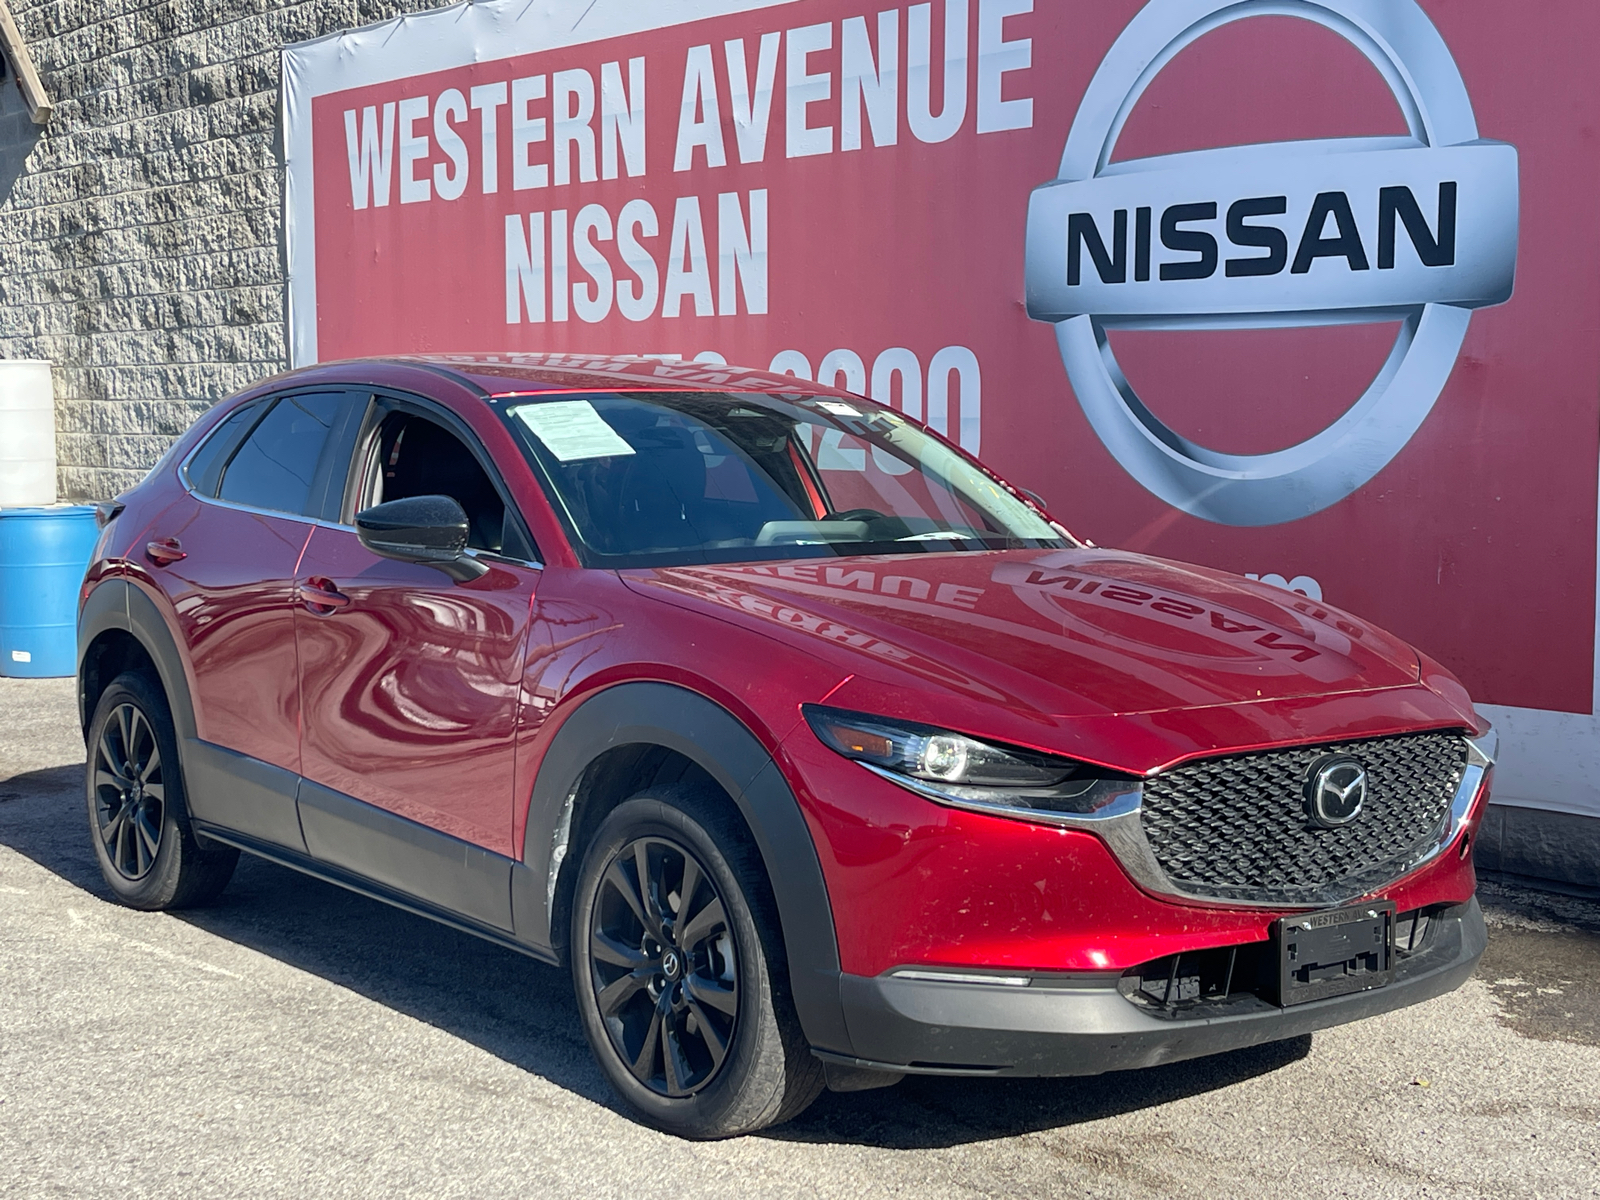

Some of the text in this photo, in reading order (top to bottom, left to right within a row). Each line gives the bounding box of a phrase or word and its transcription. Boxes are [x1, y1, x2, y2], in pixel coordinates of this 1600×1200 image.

[344, 0, 1034, 210] WESTERN AVENUE
[505, 189, 768, 324] NISSAN
[1066, 181, 1457, 286] NISSAN
[1309, 910, 1350, 927] WESTERN
